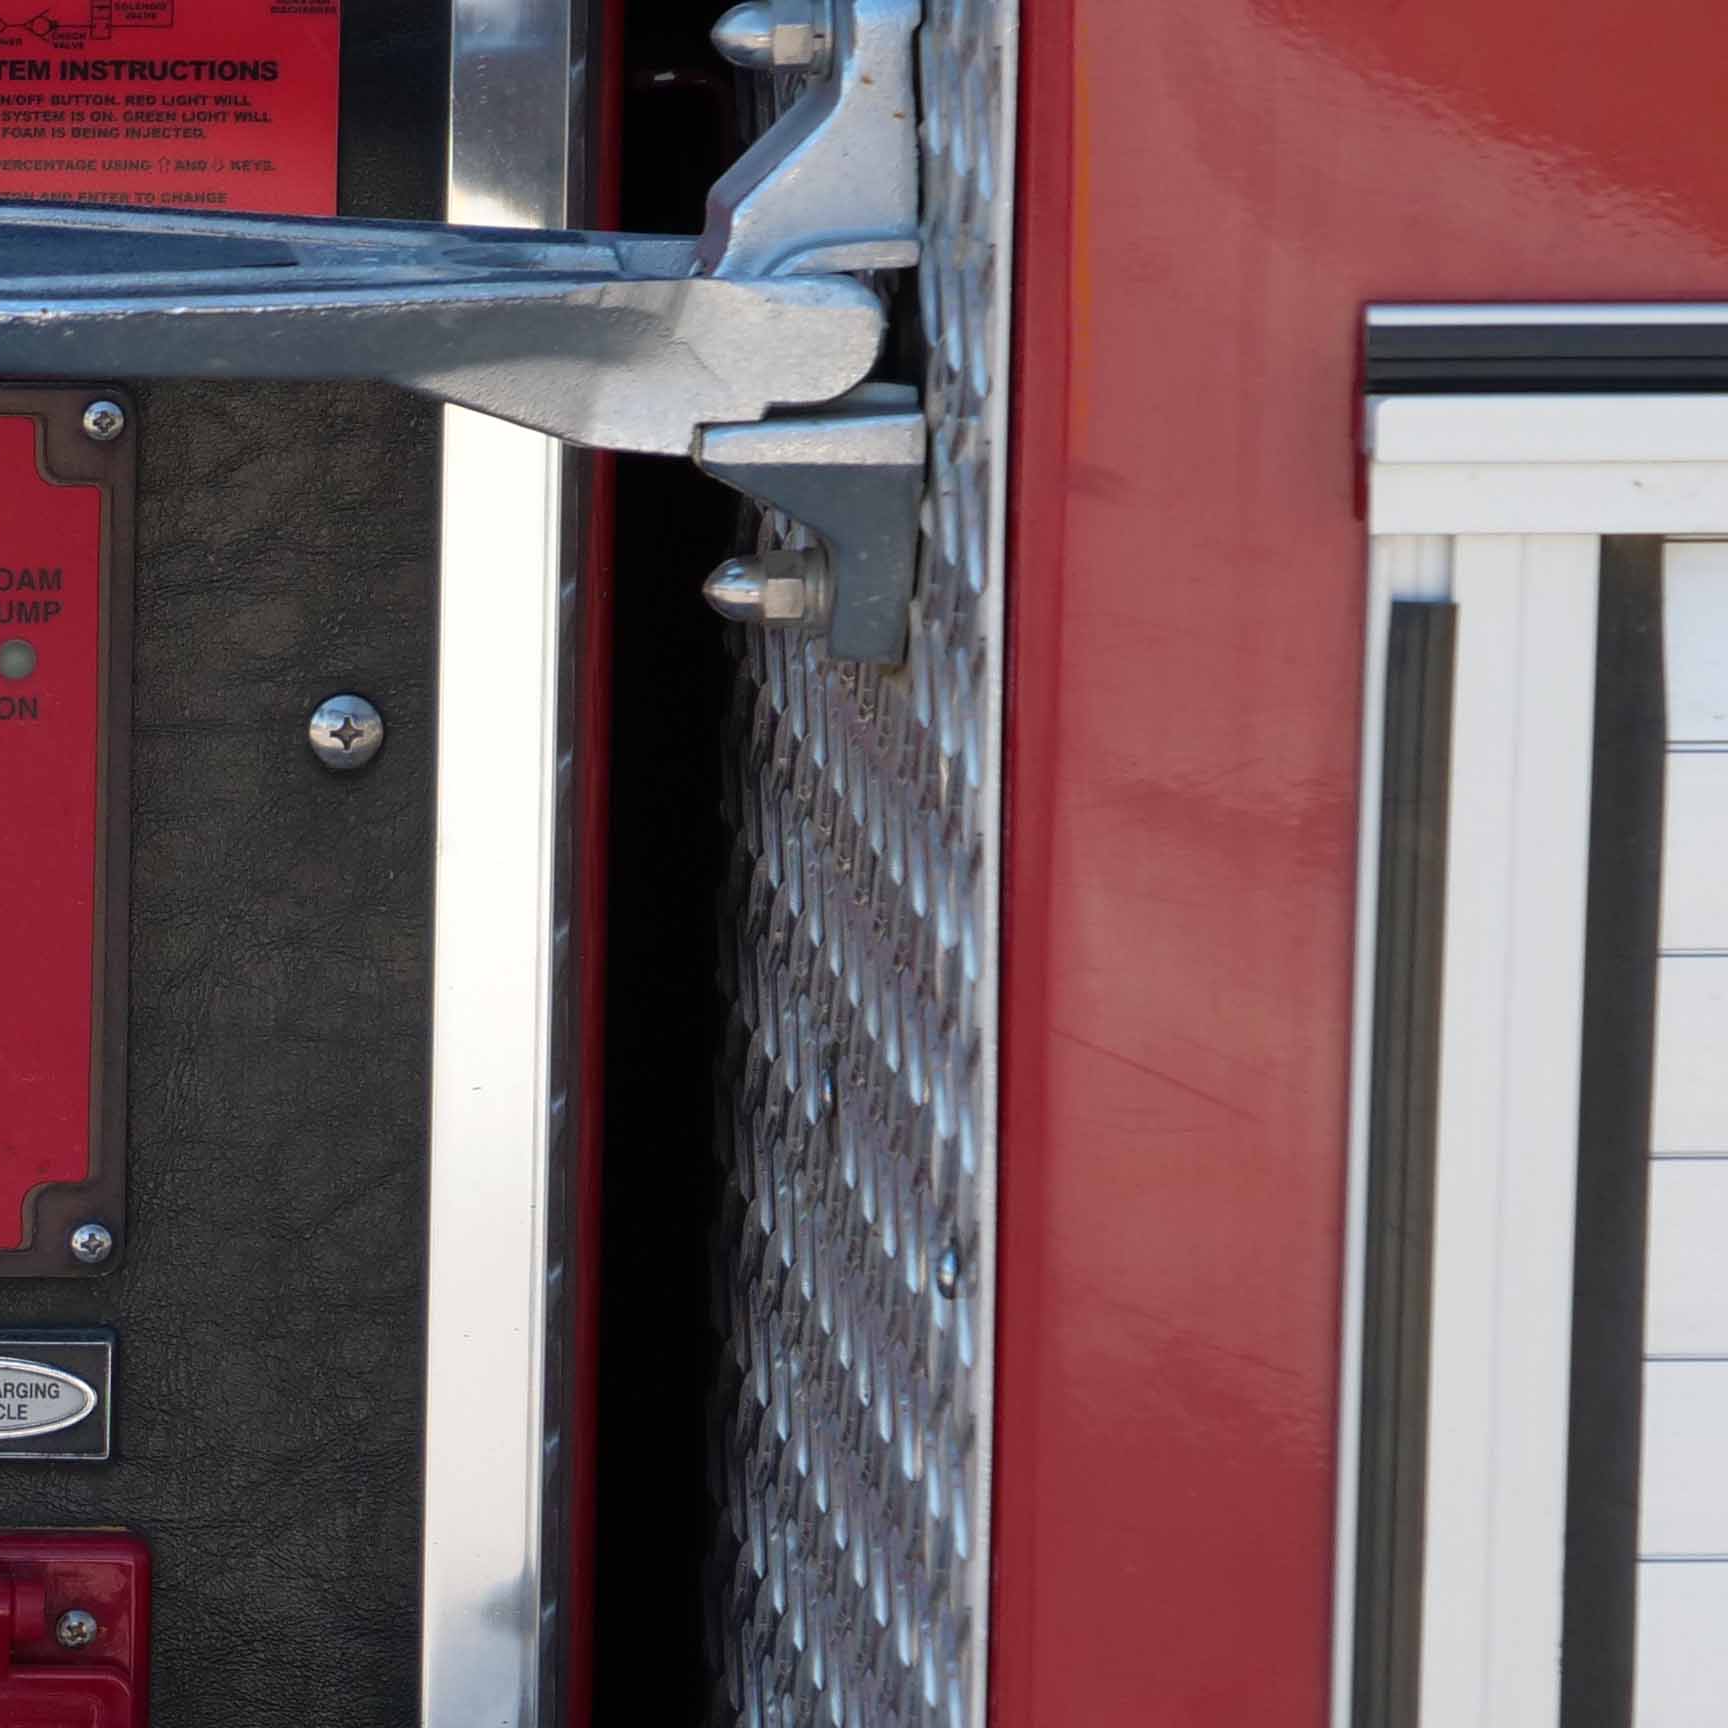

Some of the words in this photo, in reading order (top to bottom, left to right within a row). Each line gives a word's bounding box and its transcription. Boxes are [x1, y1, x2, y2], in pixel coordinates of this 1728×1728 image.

[59, 60, 279, 81] INSTRUCTIONS
[125, 95, 157, 106] RED
[162, 95, 208, 107] LIGHT
[214, 95, 251, 107] WILL
[1, 127, 45, 139] FOAM
[51, 127, 66, 139] IS
[71, 127, 120, 139] BEING
